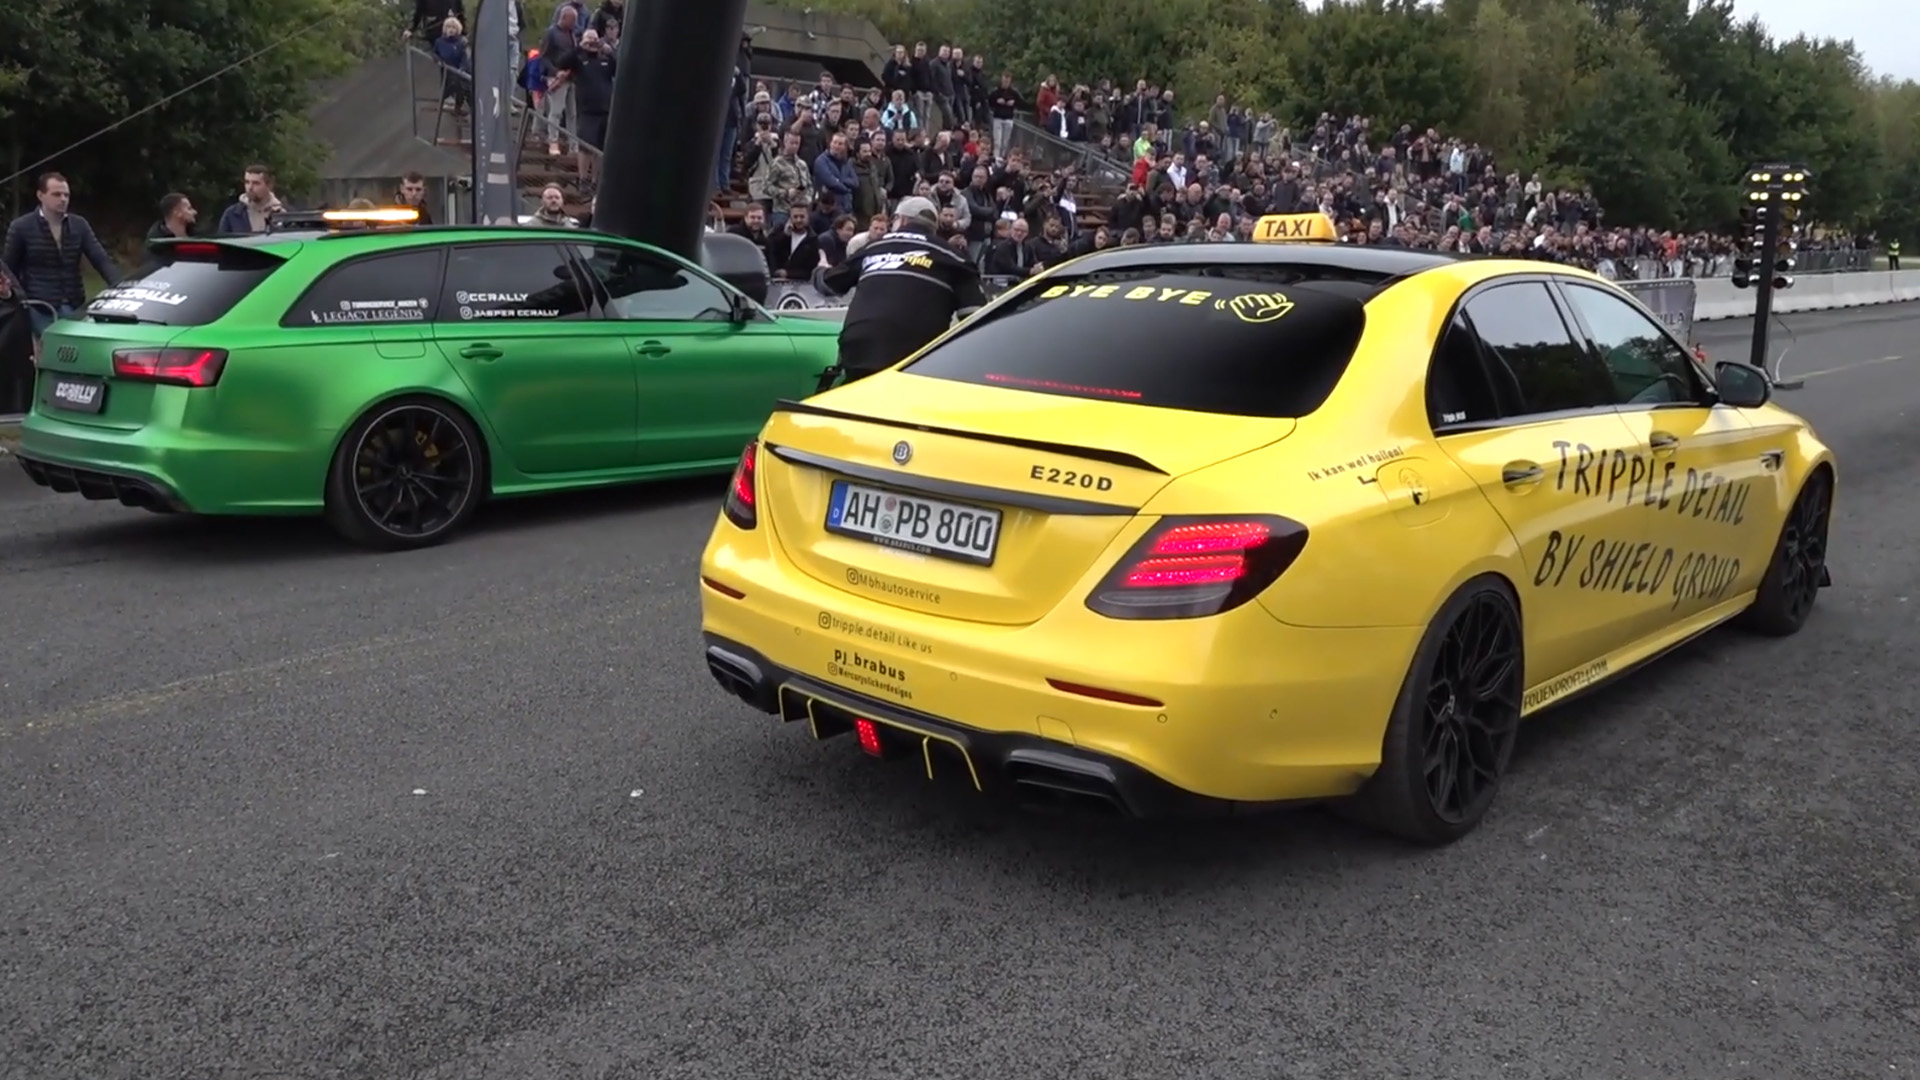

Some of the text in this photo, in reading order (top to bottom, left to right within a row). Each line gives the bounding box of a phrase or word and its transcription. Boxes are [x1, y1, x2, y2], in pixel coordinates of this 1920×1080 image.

[1264, 219, 1312, 237] TAXI
[469, 293, 528, 302] CCRALLY
[1040, 285, 1212, 305] BYE BYE
[323, 310, 369, 321] LEGACY
[371, 309, 424, 320] LEGENDS
[474, 309, 559, 317] JASPER CCRALLY
[1322, 465, 1346, 477] kan
[1346, 455, 1368, 469] wel
[1030, 465, 1112, 491] E220D
[1553, 440, 1750, 525] TRIPPLE DETAIL
[843, 491, 881, 528] AH
[895, 500, 932, 538] PB
[935, 508, 993, 551] 800
[1534, 530, 1740, 611] BY SHIELD GROUP
[920, 643, 933, 654] us
[834, 648, 906, 682] pj_brabus
